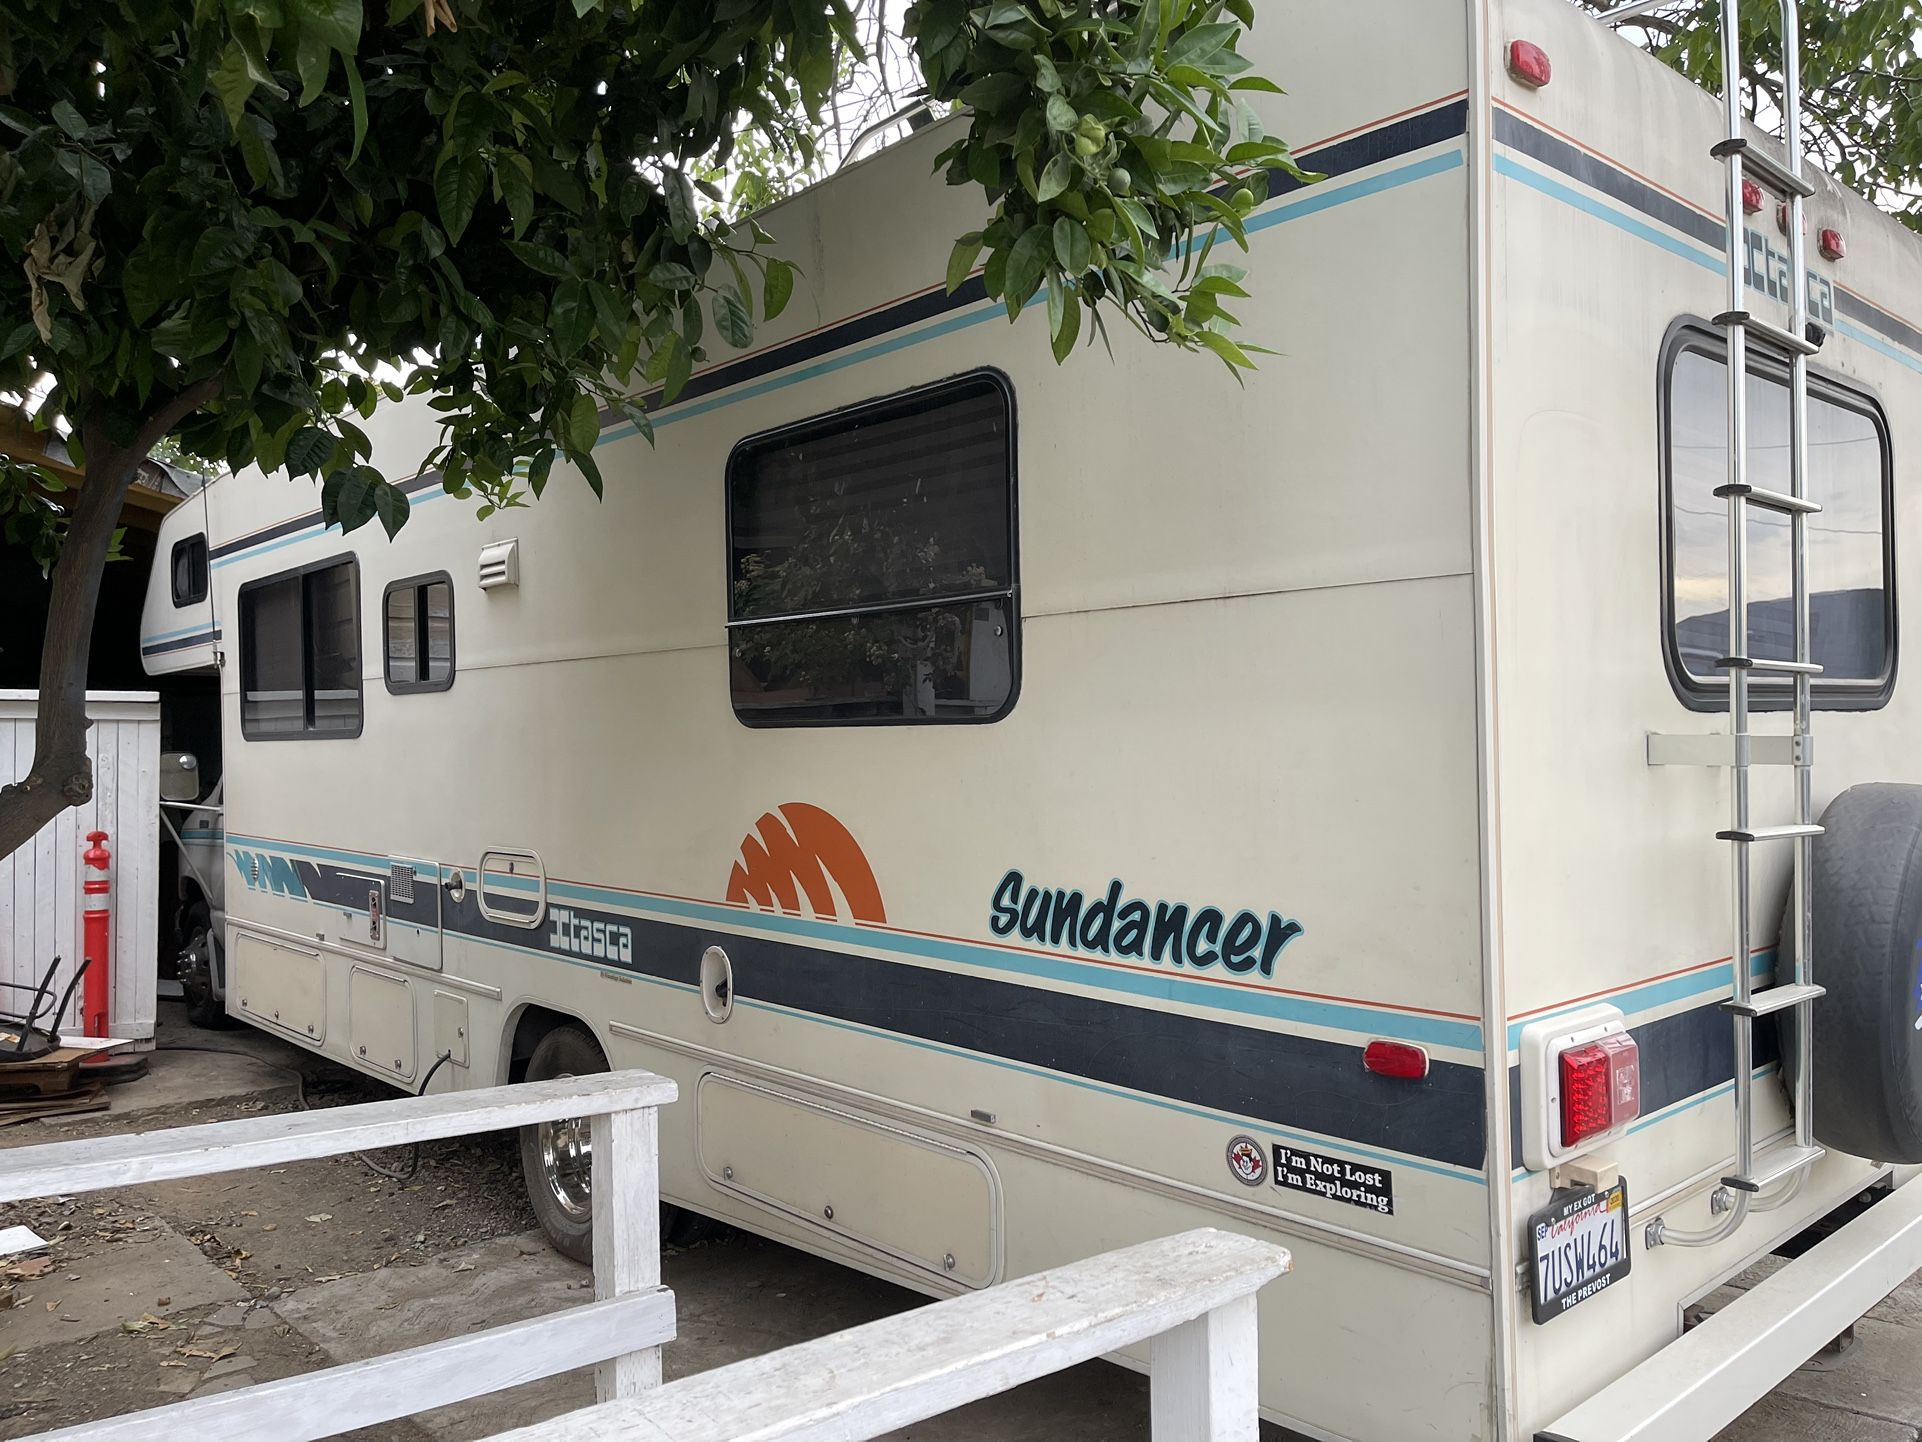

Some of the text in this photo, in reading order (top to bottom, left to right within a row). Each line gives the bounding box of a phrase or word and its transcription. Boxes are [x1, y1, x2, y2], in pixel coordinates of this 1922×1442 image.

[1743, 227, 1835, 327] Itaca
[549, 907, 633, 965] Itasca
[989, 869, 1304, 979] Sundancer
[1277, 1167, 1389, 1213] I'm Exploring
[1280, 1149, 1306, 1169] I'm
[1310, 1156, 1341, 1178] Not
[1344, 1165, 1383, 1188] Lost
[1563, 1193, 1596, 1216] MY EX GOT
[1539, 1219, 1620, 1303] 7USW464
[1561, 1273, 1611, 1310] THE PREVOST
